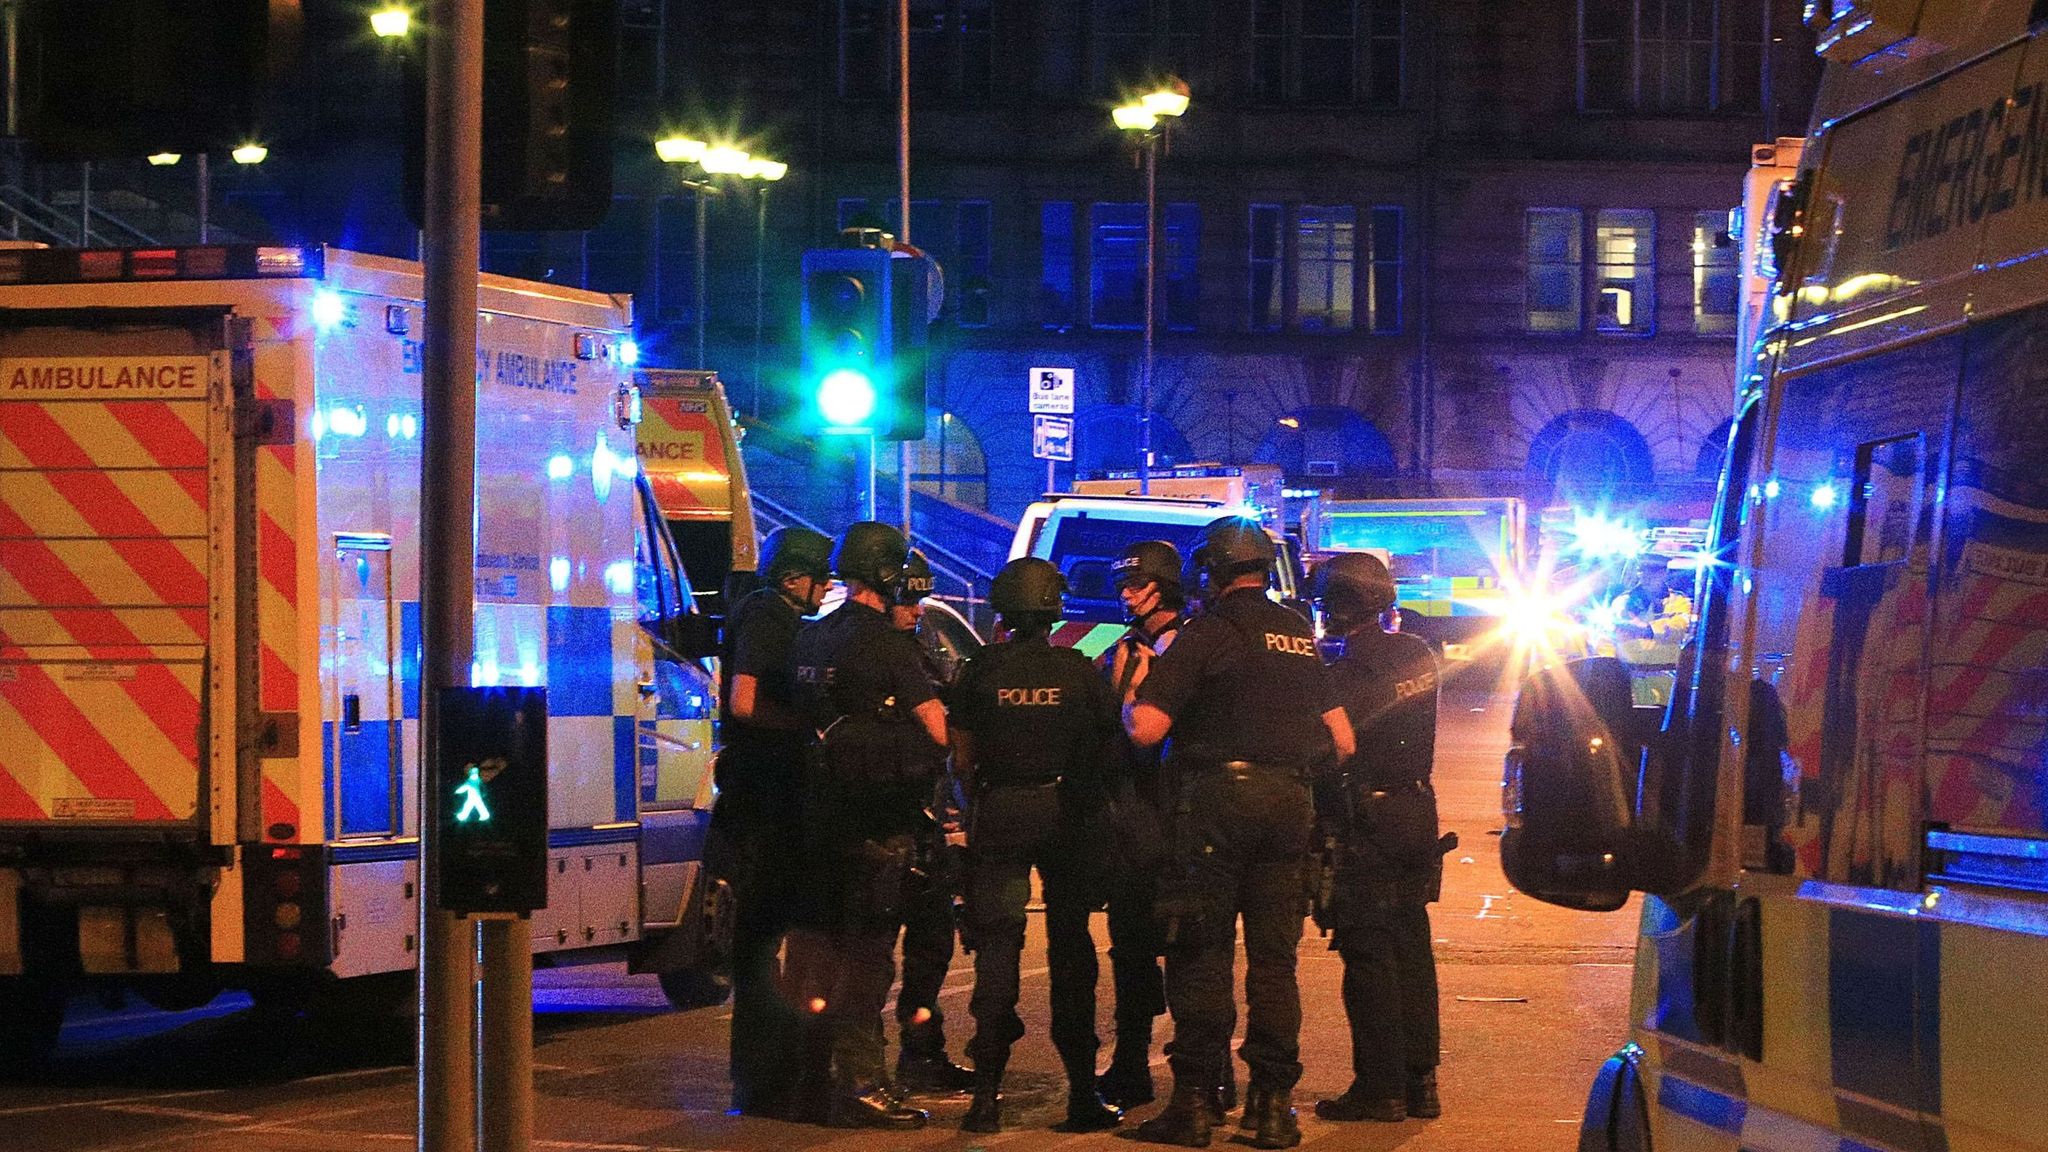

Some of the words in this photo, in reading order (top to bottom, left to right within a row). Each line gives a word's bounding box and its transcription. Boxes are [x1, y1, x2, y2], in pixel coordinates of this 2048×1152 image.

[10, 366, 197, 390] AMBULANCE
[498, 351, 577, 395] AMBULANCE
[1265, 633, 1316, 657] POLICE
[998, 688, 1060, 705] POLICE
